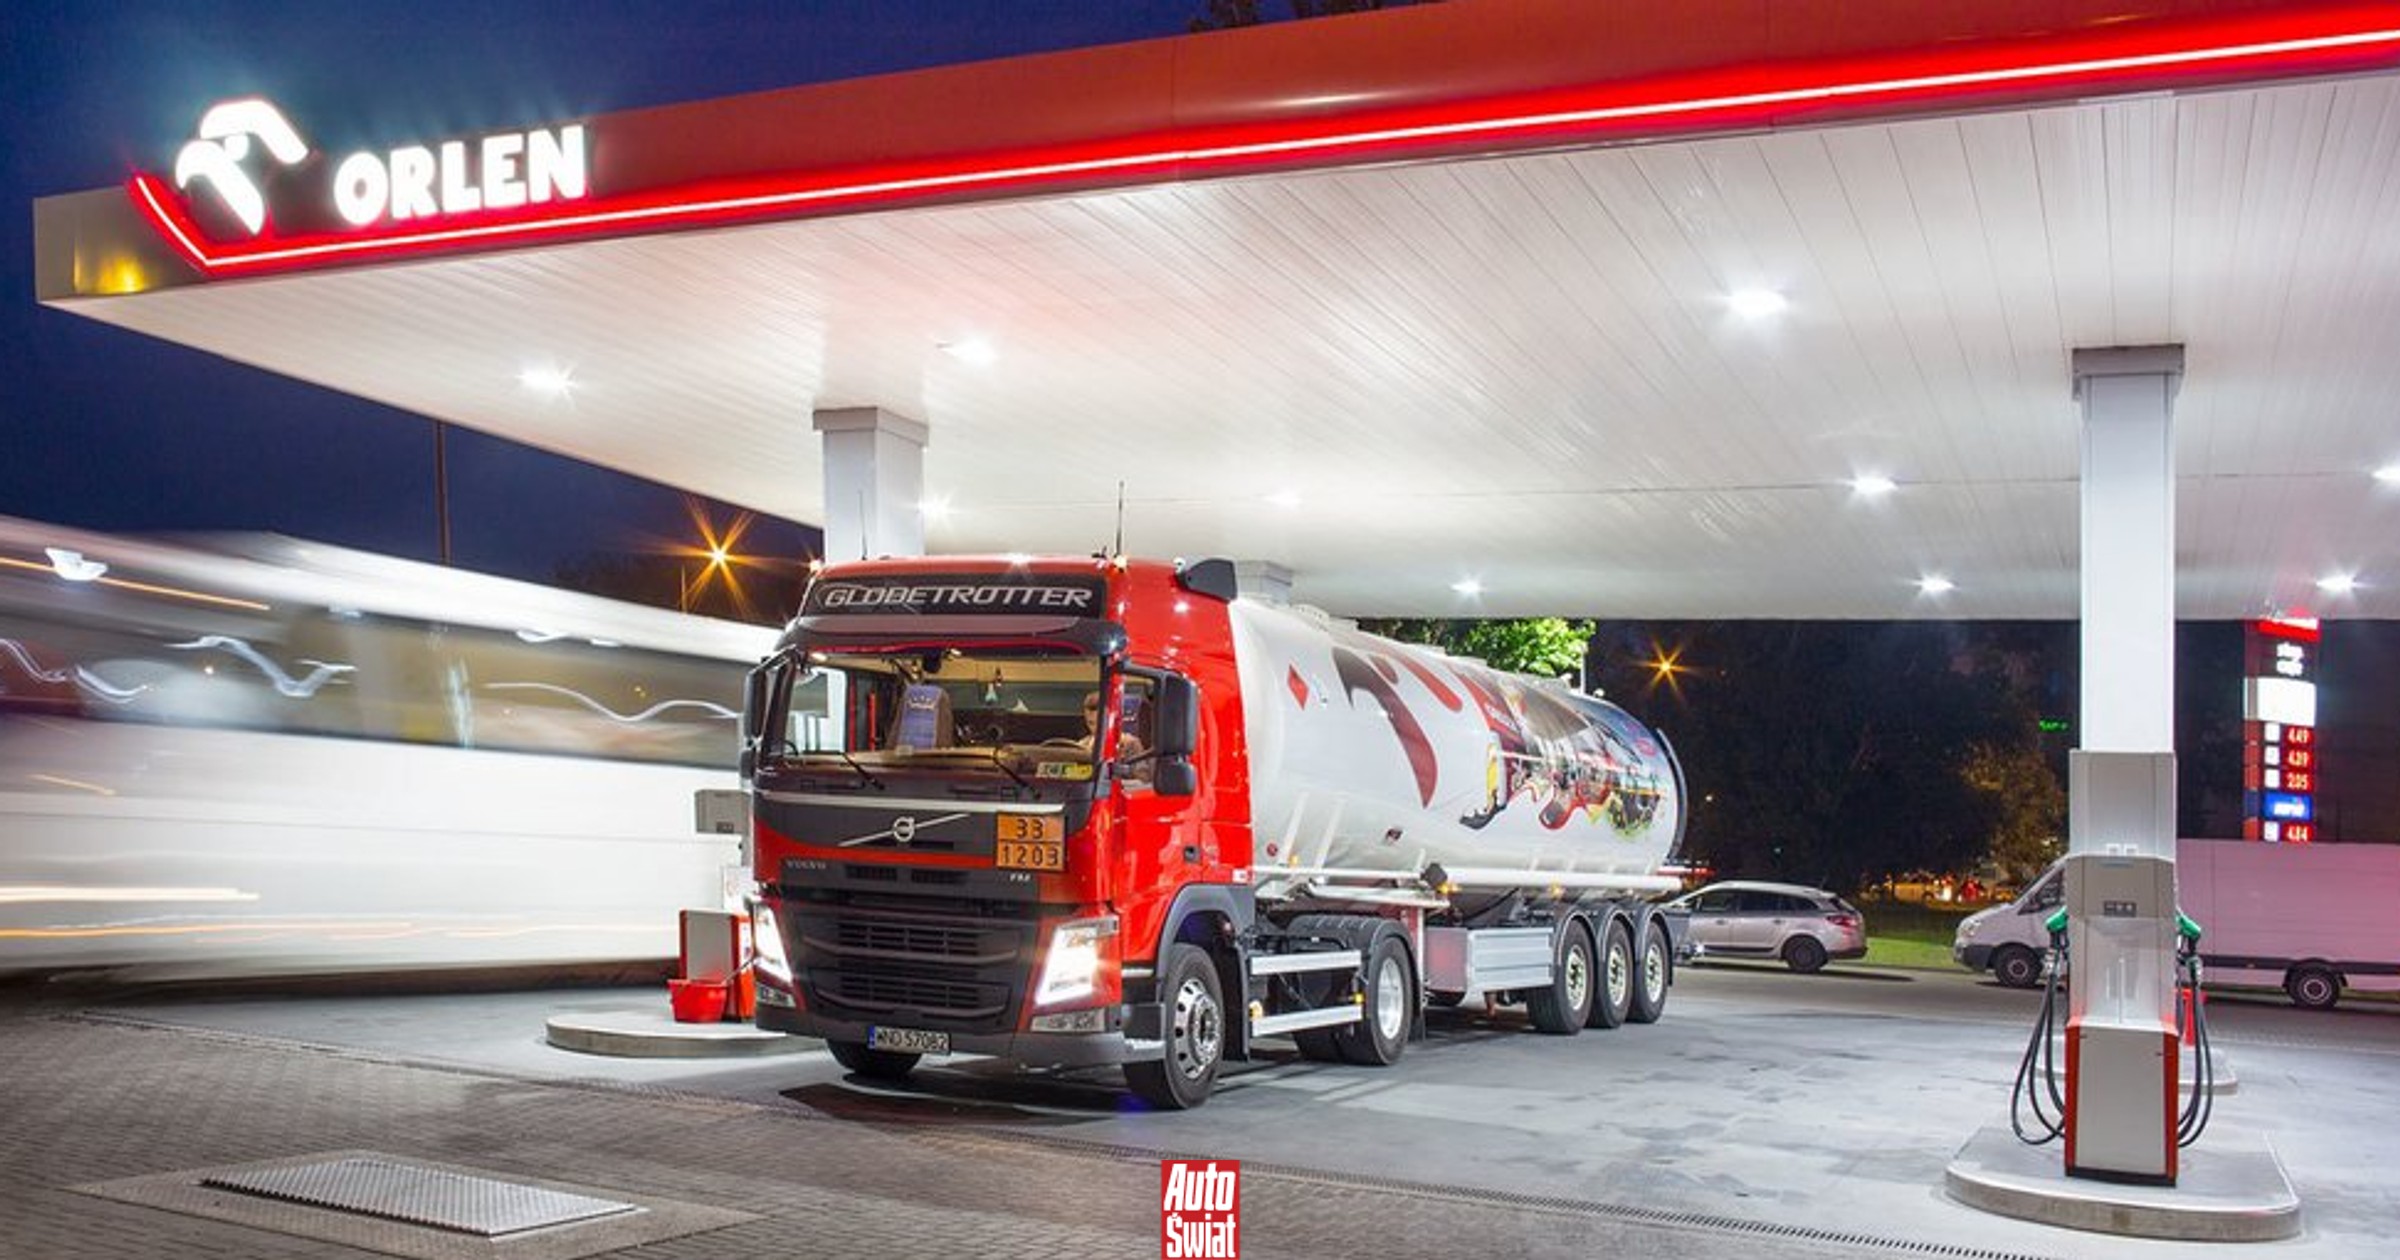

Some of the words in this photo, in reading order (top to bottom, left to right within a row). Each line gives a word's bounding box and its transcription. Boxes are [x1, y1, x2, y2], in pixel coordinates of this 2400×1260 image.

[334, 125, 585, 226] ORLEN
[825, 586, 1092, 608] GLOBETROTTER
[1017, 818, 1043, 839] 33
[1003, 845, 1058, 866] 1203
